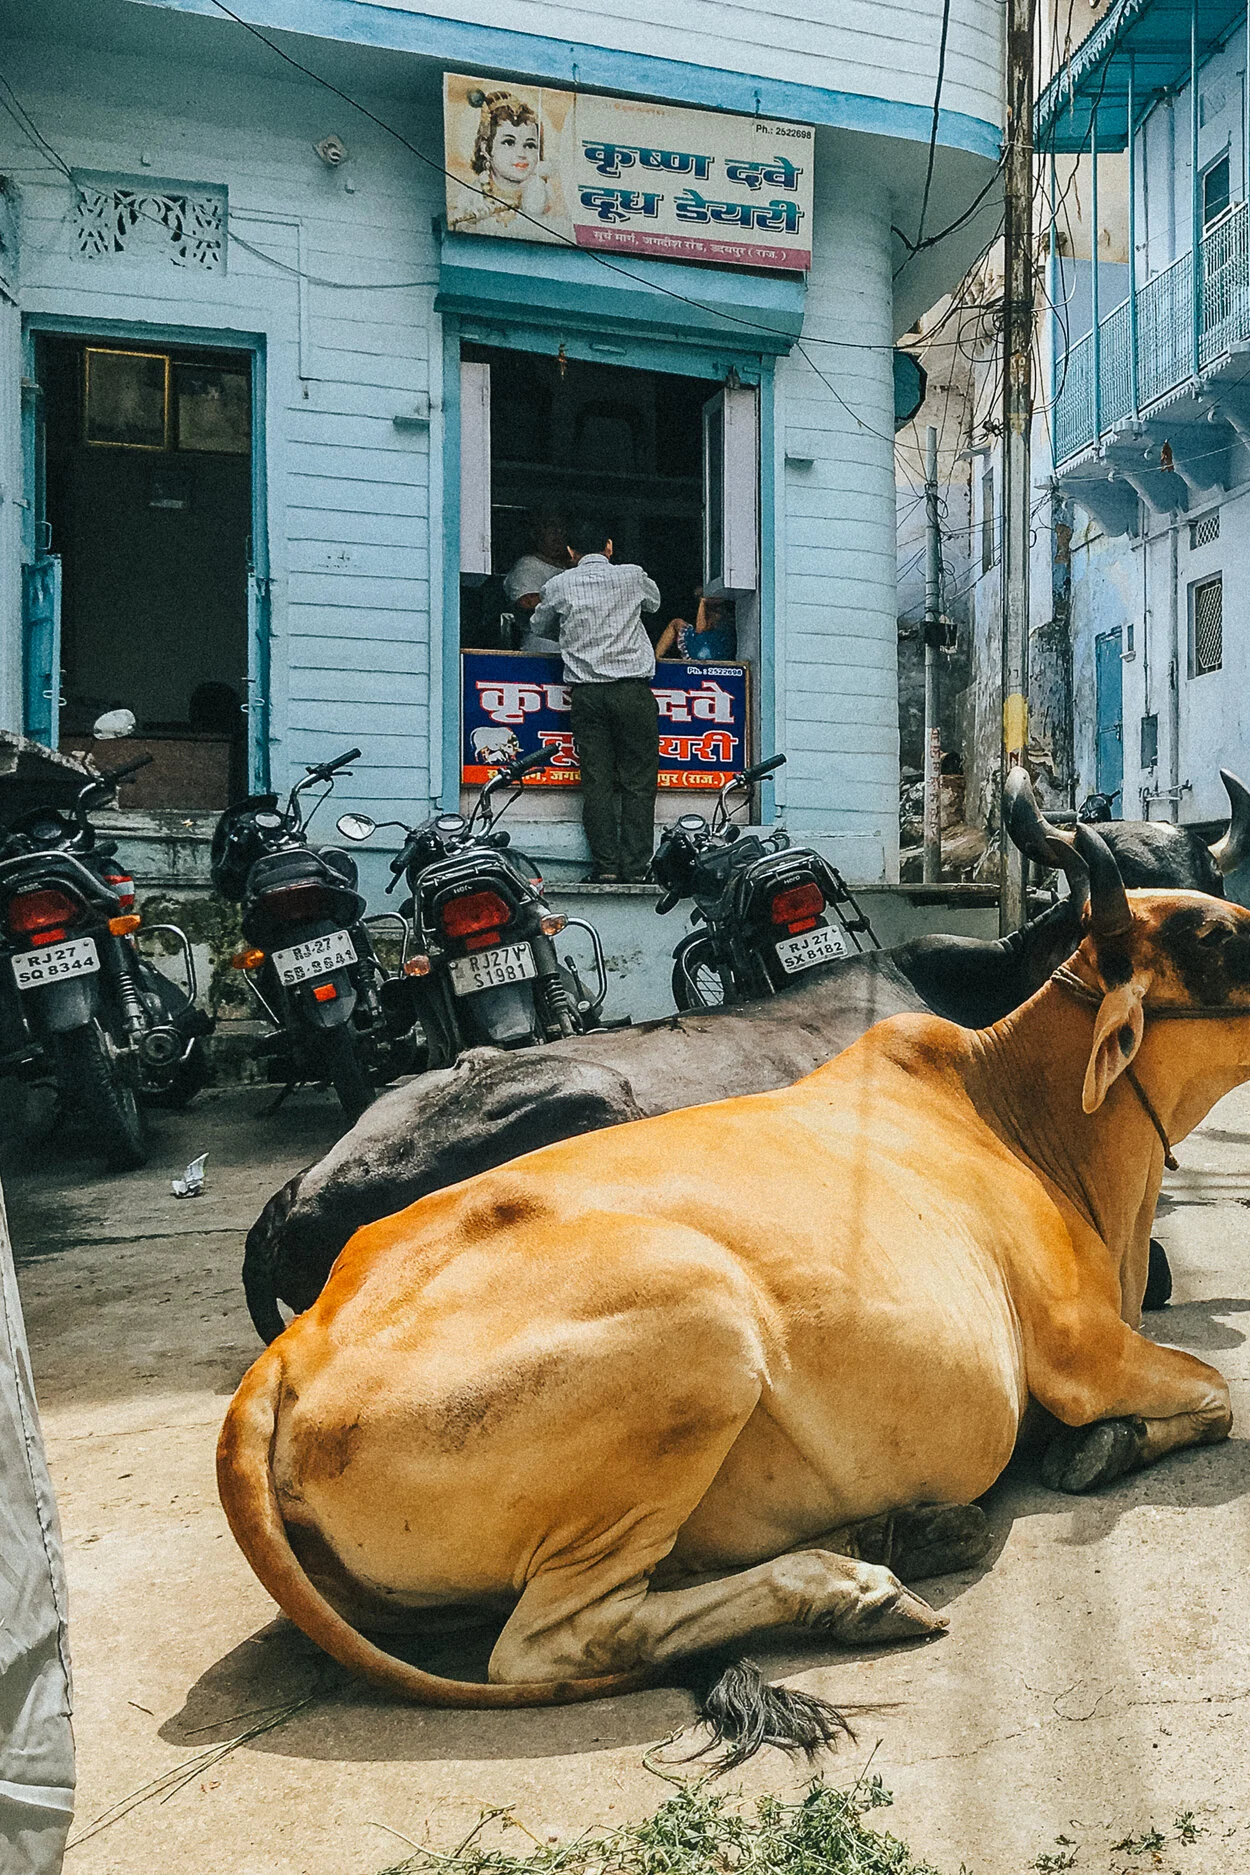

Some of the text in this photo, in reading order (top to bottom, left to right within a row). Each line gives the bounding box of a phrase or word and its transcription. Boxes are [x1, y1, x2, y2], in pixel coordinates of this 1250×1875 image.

[775, 127, 812, 140] 2522698
[581, 139, 803, 192] कृष्ण दवे
[578, 184, 805, 235] दूध डेयरी
[806, 942, 843, 959] 8182
[48, 956, 94, 975] 8344
[473, 963, 527, 988] S1981
